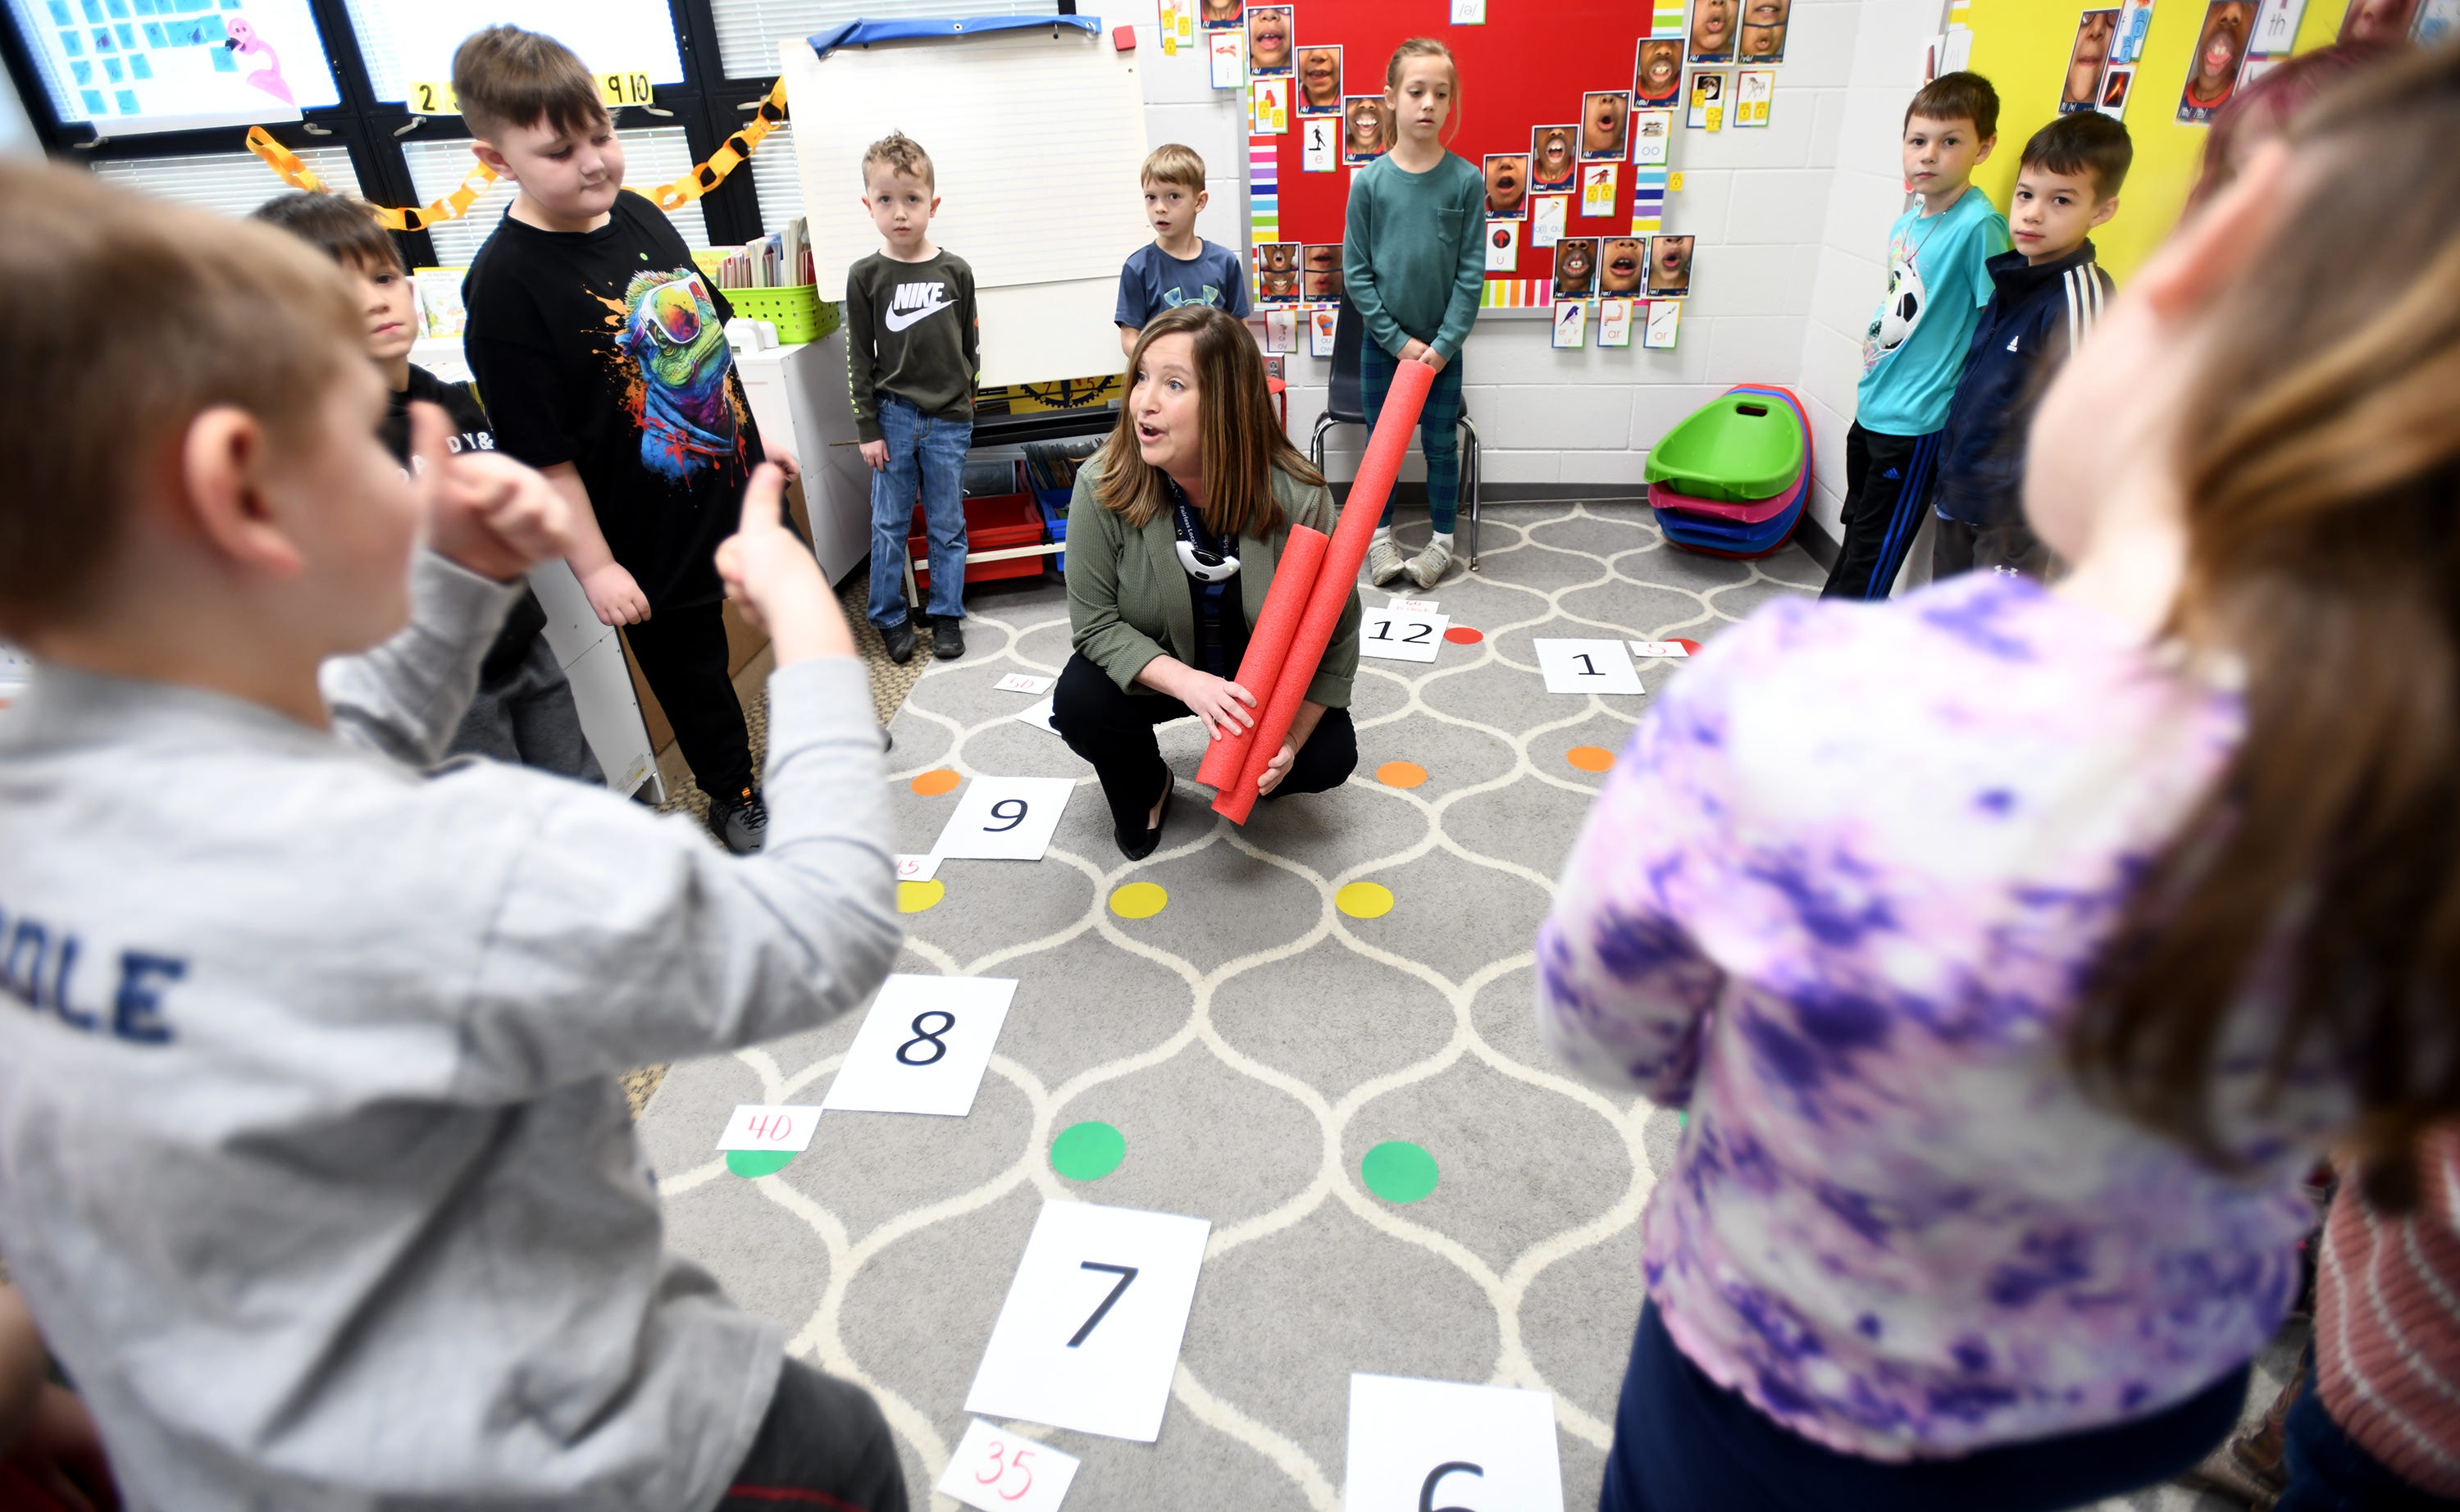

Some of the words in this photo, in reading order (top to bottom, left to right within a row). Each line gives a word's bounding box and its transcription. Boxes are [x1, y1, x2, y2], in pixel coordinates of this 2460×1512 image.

[2268, 12, 2286, 36] th
[419, 84, 435, 112] 2
[608, 75, 624, 103] 9
[630, 75, 649, 102] 10
[893, 282, 945, 310] NIKE
[1607, 330, 1621, 339] ar
[1654, 331, 1669, 340] or
[1042, 381, 1053, 394] 7
[1086, 376, 1096, 389] 5
[1179, 505, 1191, 529] Fairless
[1368, 621, 1433, 644] 12
[1647, 643, 1667, 655] 5
[1572, 654, 1606, 676] 1
[1008, 677, 1035, 689] 50
[982, 799, 1028, 832] 9
[895, 1011, 956, 1067] 8
[747, 1114, 792, 1141] 40
[1065, 1260, 1140, 1349] 7
[974, 1440, 1036, 1501] 35
